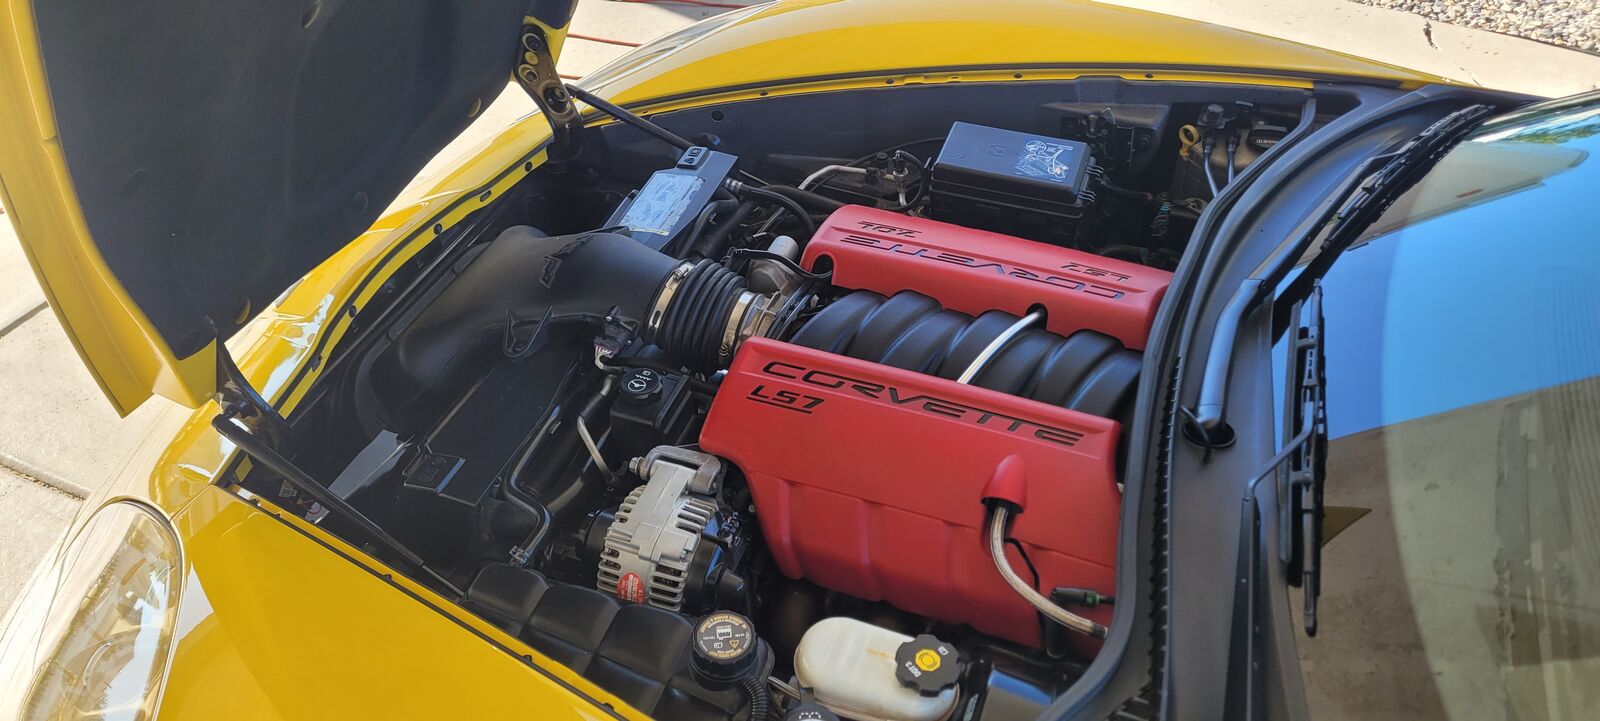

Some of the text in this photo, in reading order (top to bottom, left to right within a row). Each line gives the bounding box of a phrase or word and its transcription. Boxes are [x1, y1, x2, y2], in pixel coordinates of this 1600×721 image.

[840, 234, 1125, 299] CORVETTE
[1060, 262, 1132, 282] LS7
[748, 385, 825, 412] LS7
[762, 360, 1084, 447] CORVETTE
